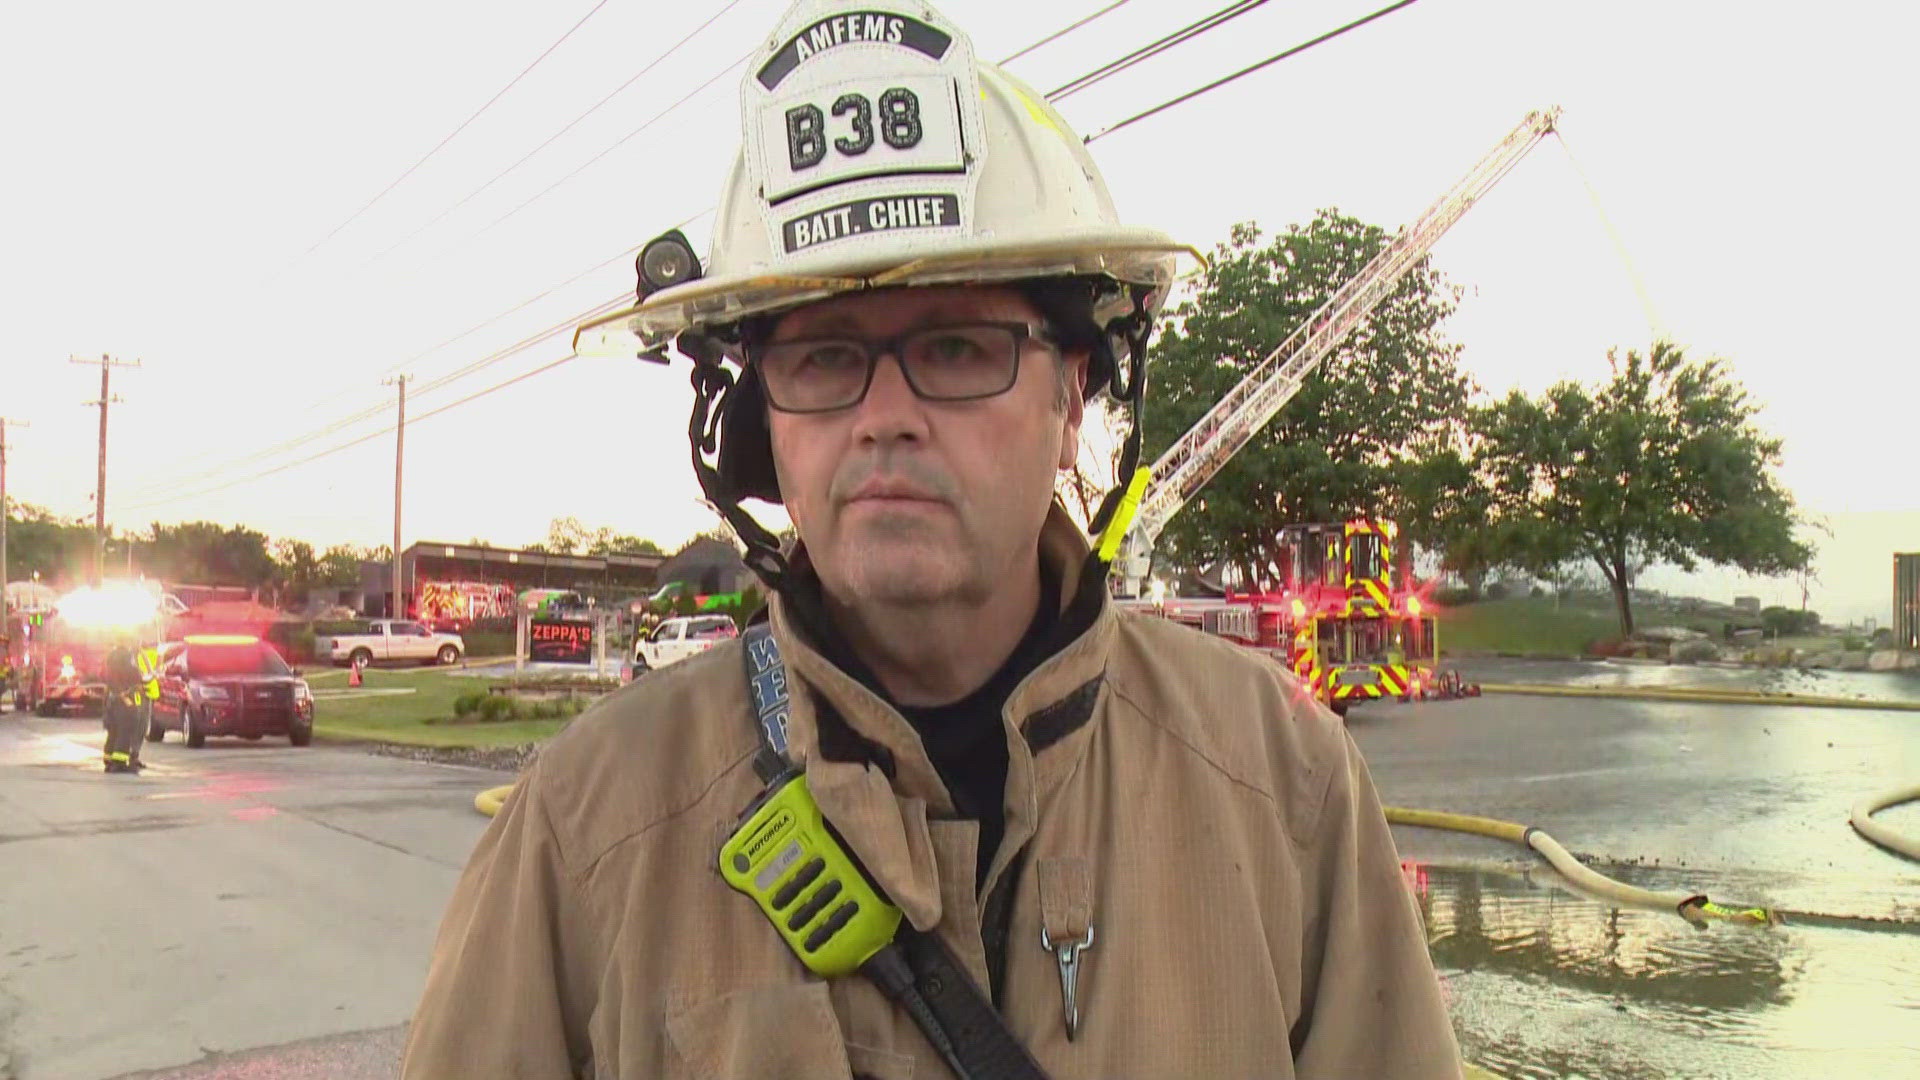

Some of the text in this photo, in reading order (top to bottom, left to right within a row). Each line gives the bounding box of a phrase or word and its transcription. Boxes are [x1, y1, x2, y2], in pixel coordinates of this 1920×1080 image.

[795, 14, 905, 63] AMFEMS
[785, 87, 923, 172] B38
[794, 197, 945, 248] BATT. CHIEF
[532, 623, 591, 641] ZEPPA'S
[747, 814, 790, 858] MOTOROLA
